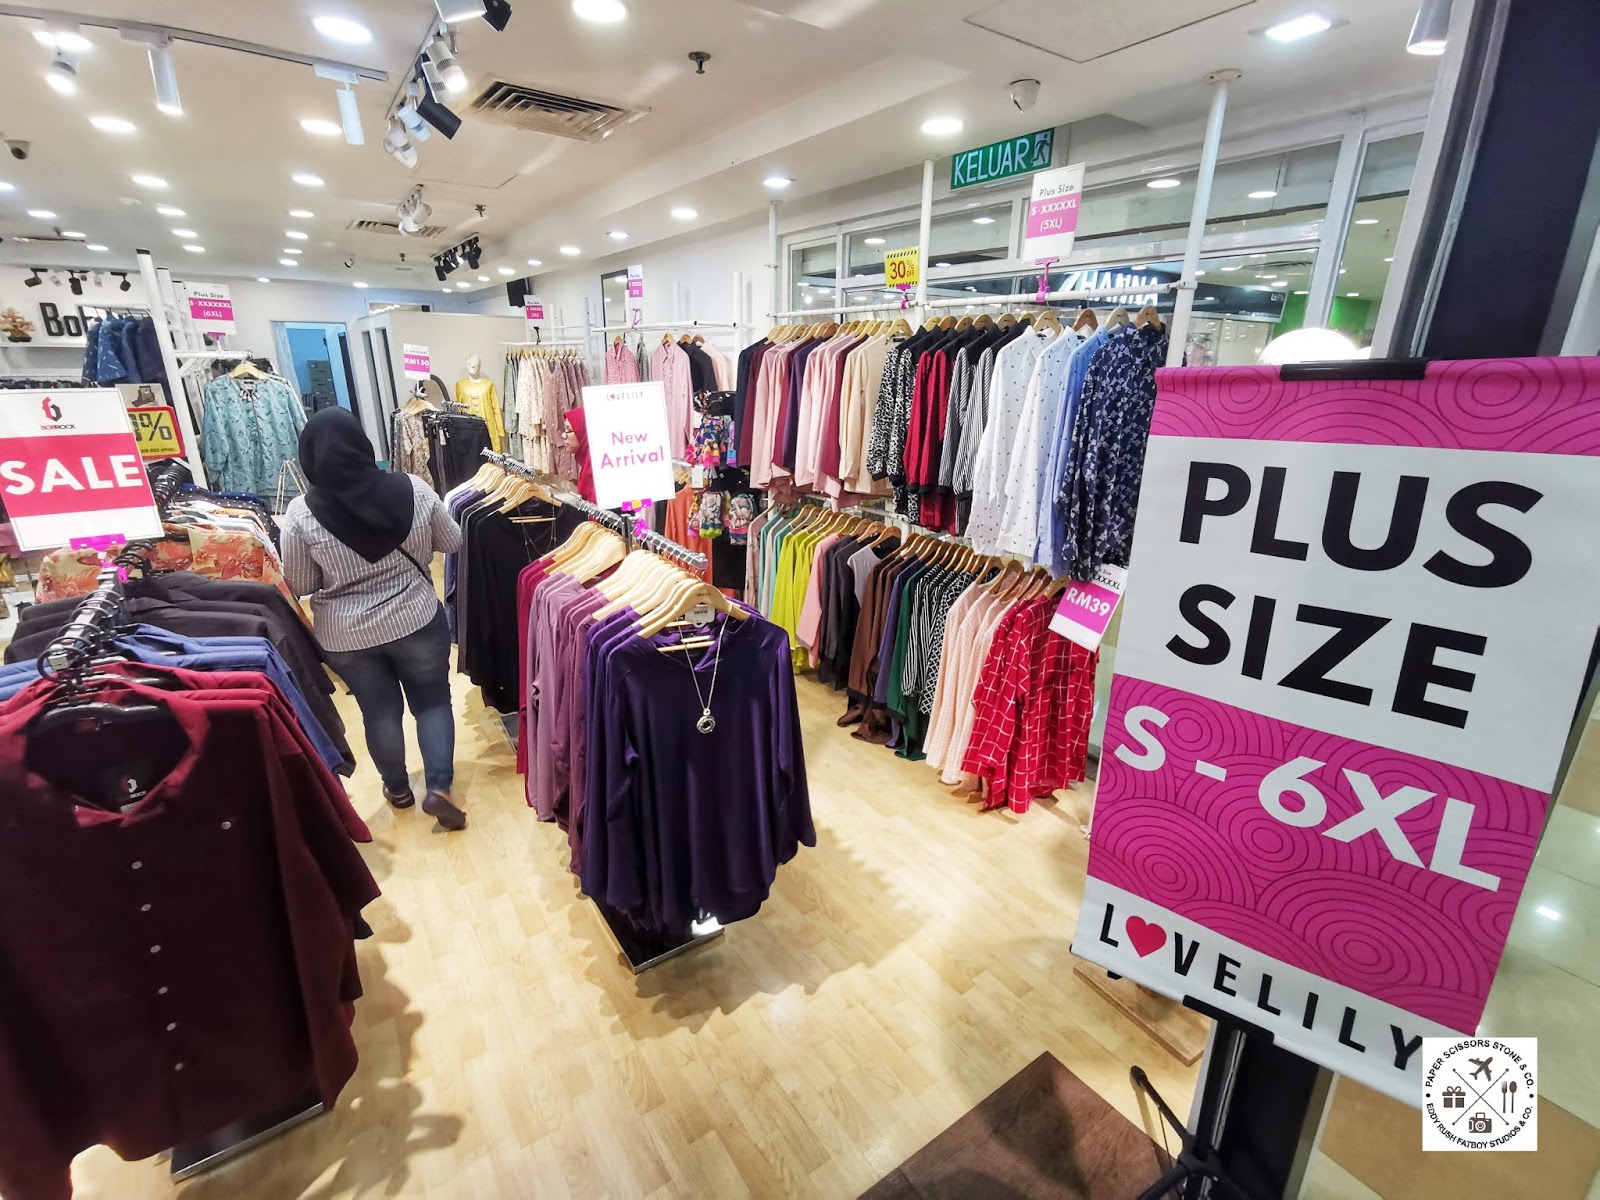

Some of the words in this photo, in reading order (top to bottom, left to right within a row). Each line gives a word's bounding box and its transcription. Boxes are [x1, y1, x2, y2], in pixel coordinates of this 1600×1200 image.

[953, 137, 1031, 186] KELUAR
[1040, 188, 1055, 197] Plus
[1058, 184, 1074, 194] Size
[1040, 217, 1063, 232] (5XL)
[405, 357, 430, 367] RM150
[611, 431, 648, 446] New
[600, 445, 664, 470] Arrival
[0, 454, 144, 496] SALE
[1179, 461, 1545, 589] PLUS
[1066, 586, 1111, 617] RM39
[1165, 583, 1489, 730] SIZE
[1114, 705, 1170, 771] S
[1258, 755, 1501, 892] 6XL
